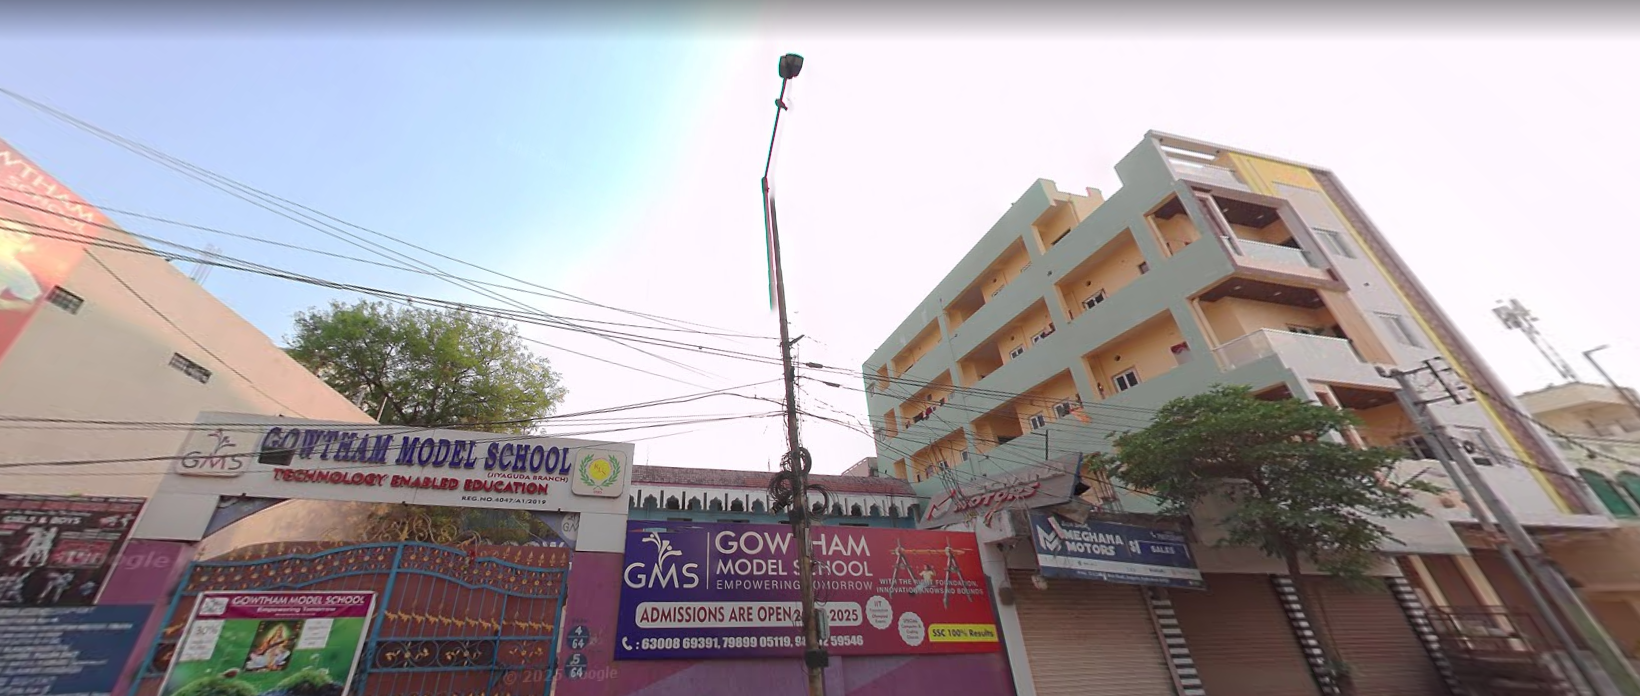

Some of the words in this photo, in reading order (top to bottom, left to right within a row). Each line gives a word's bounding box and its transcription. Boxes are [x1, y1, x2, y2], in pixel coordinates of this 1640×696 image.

[261, 427, 394, 465] GOWTHAM
[394, 436, 478, 470] MODEL
[484, 442, 572, 476] SCHOOL
[181, 451, 243, 471] GMS
[273, 468, 389, 487] TECHNOLOGY
[390, 474, 460, 492] ENABLED
[463, 479, 549, 496] EDUCATION
[487, 471, 531, 480] (JIYAGUDA
[532, 474, 569, 484] BRANCH)
[715, 531, 871, 557] GOWHAM
[1063, 528, 1124, 545] MEGHANA
[1065, 540, 1116, 556] MOTORS
[624, 562, 700, 589] GMS
[716, 559, 788, 576] MODEL
[716, 579, 801, 590] EMPOWERING
[813, 580, 873, 591] OMORROW
[231, 595, 289, 606] GOWTHAM
[288, 595, 322, 605] MODEL
[324, 595, 365, 605] SCHOOL
[640, 605, 725, 624] ADMISSIONS
[728, 605, 754, 623] ARE
[757, 605, 792, 623] OPEN
[574, 626, 583, 635] 4
[932, 629, 945, 637] SSC
[948, 629, 968, 637] 100%
[969, 628, 994, 637] Results
[571, 638, 584, 649] 64
[641, 637, 680, 650] 63008
[682, 637, 721, 650] 69391,
[722, 636, 757, 649] 79899
[759, 636, 794, 649] 05119,
[831, 635, 864, 647] 59546
[570, 667, 583, 678] 64
